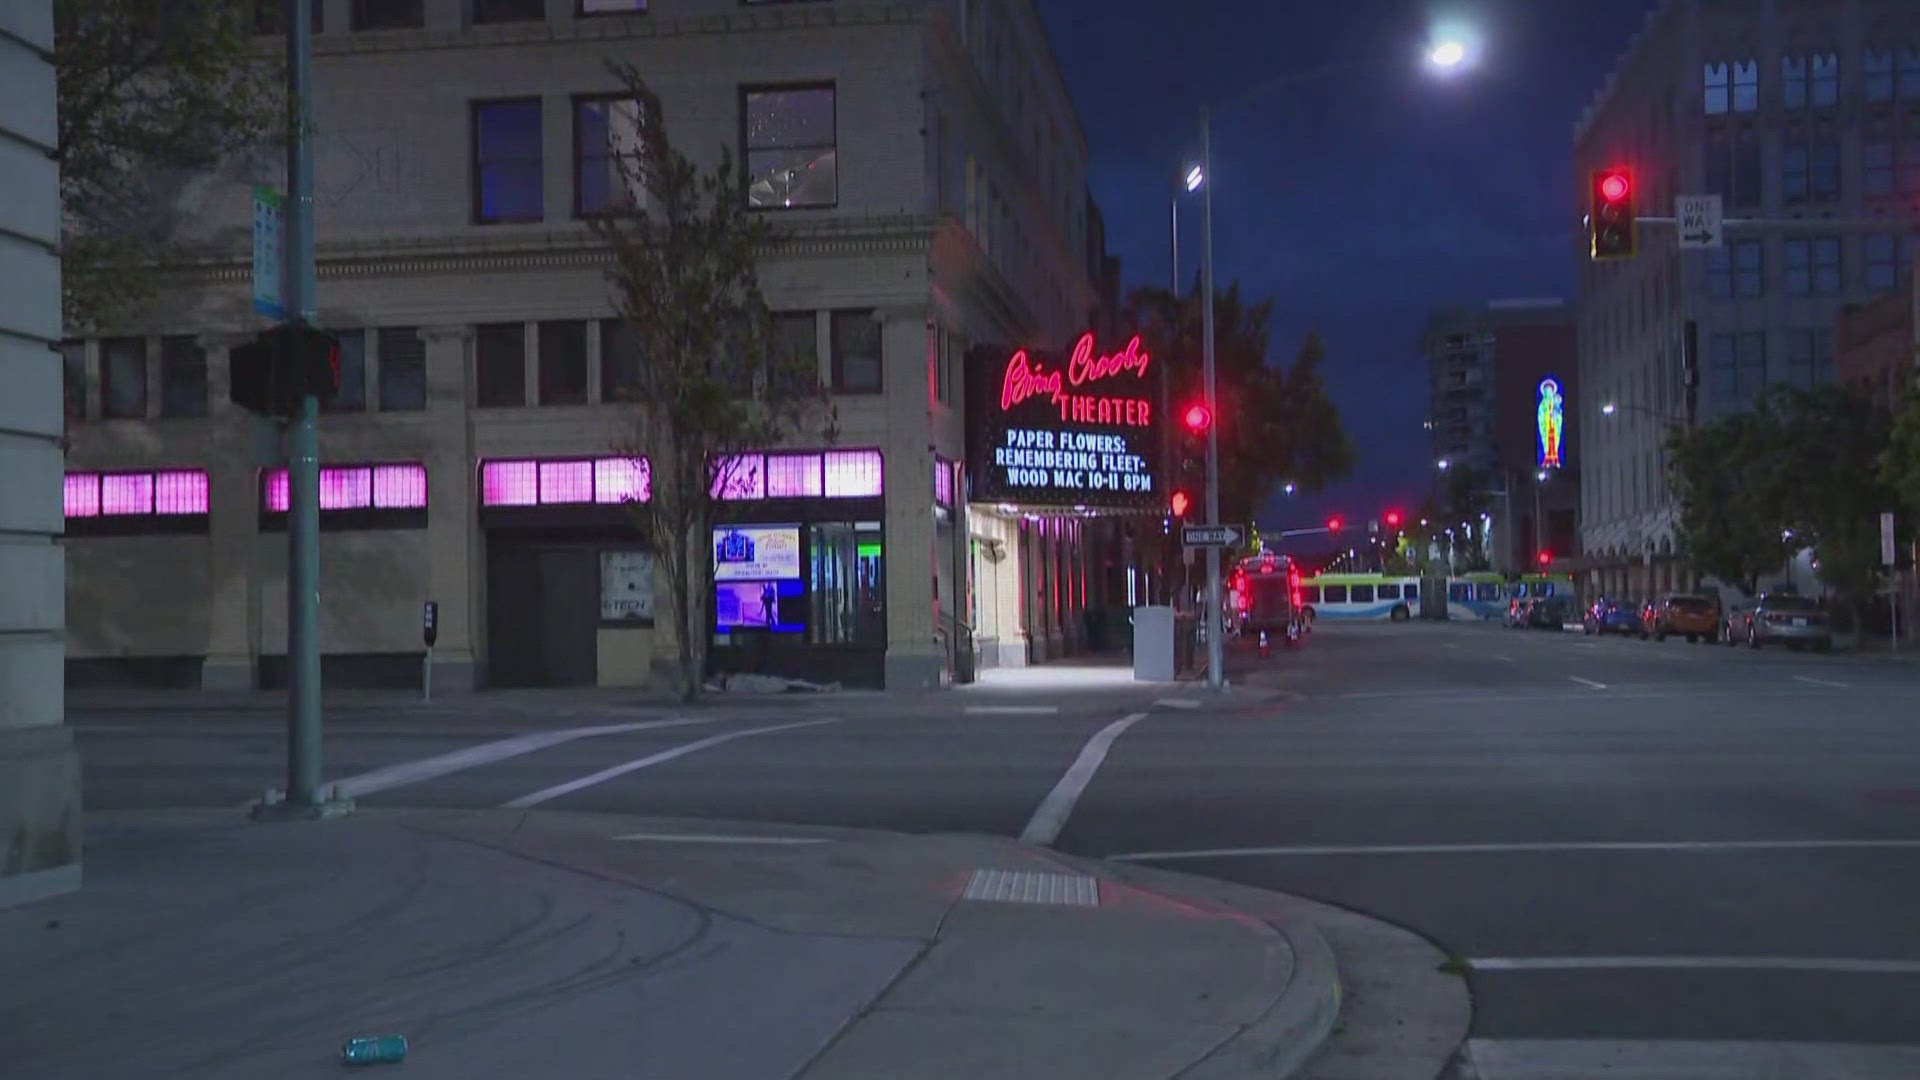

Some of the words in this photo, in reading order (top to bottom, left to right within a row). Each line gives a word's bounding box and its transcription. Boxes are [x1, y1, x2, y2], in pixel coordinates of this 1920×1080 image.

[1684, 201, 1712, 213] ONE
[1683, 213, 1713, 229] WAY
[1001, 350, 1061, 411] Bing
[1068, 332, 1149, 386] Crosby
[1059, 395, 1150, 426] THEATER
[1007, 429, 1054, 449] PAPER
[1060, 432, 1126, 453] FLOWERS:
[996, 447, 1097, 470] REMEMBERING
[1102, 454, 1146, 473] FLEET-
[1007, 468, 1048, 488] WOOD
[1054, 471, 1084, 489] MAC
[1088, 472, 1119, 491] 10-11
[1124, 473, 1151, 492] 8PM
[1188, 531, 1204, 542] ONE
[1208, 531, 1225, 542] WAY
